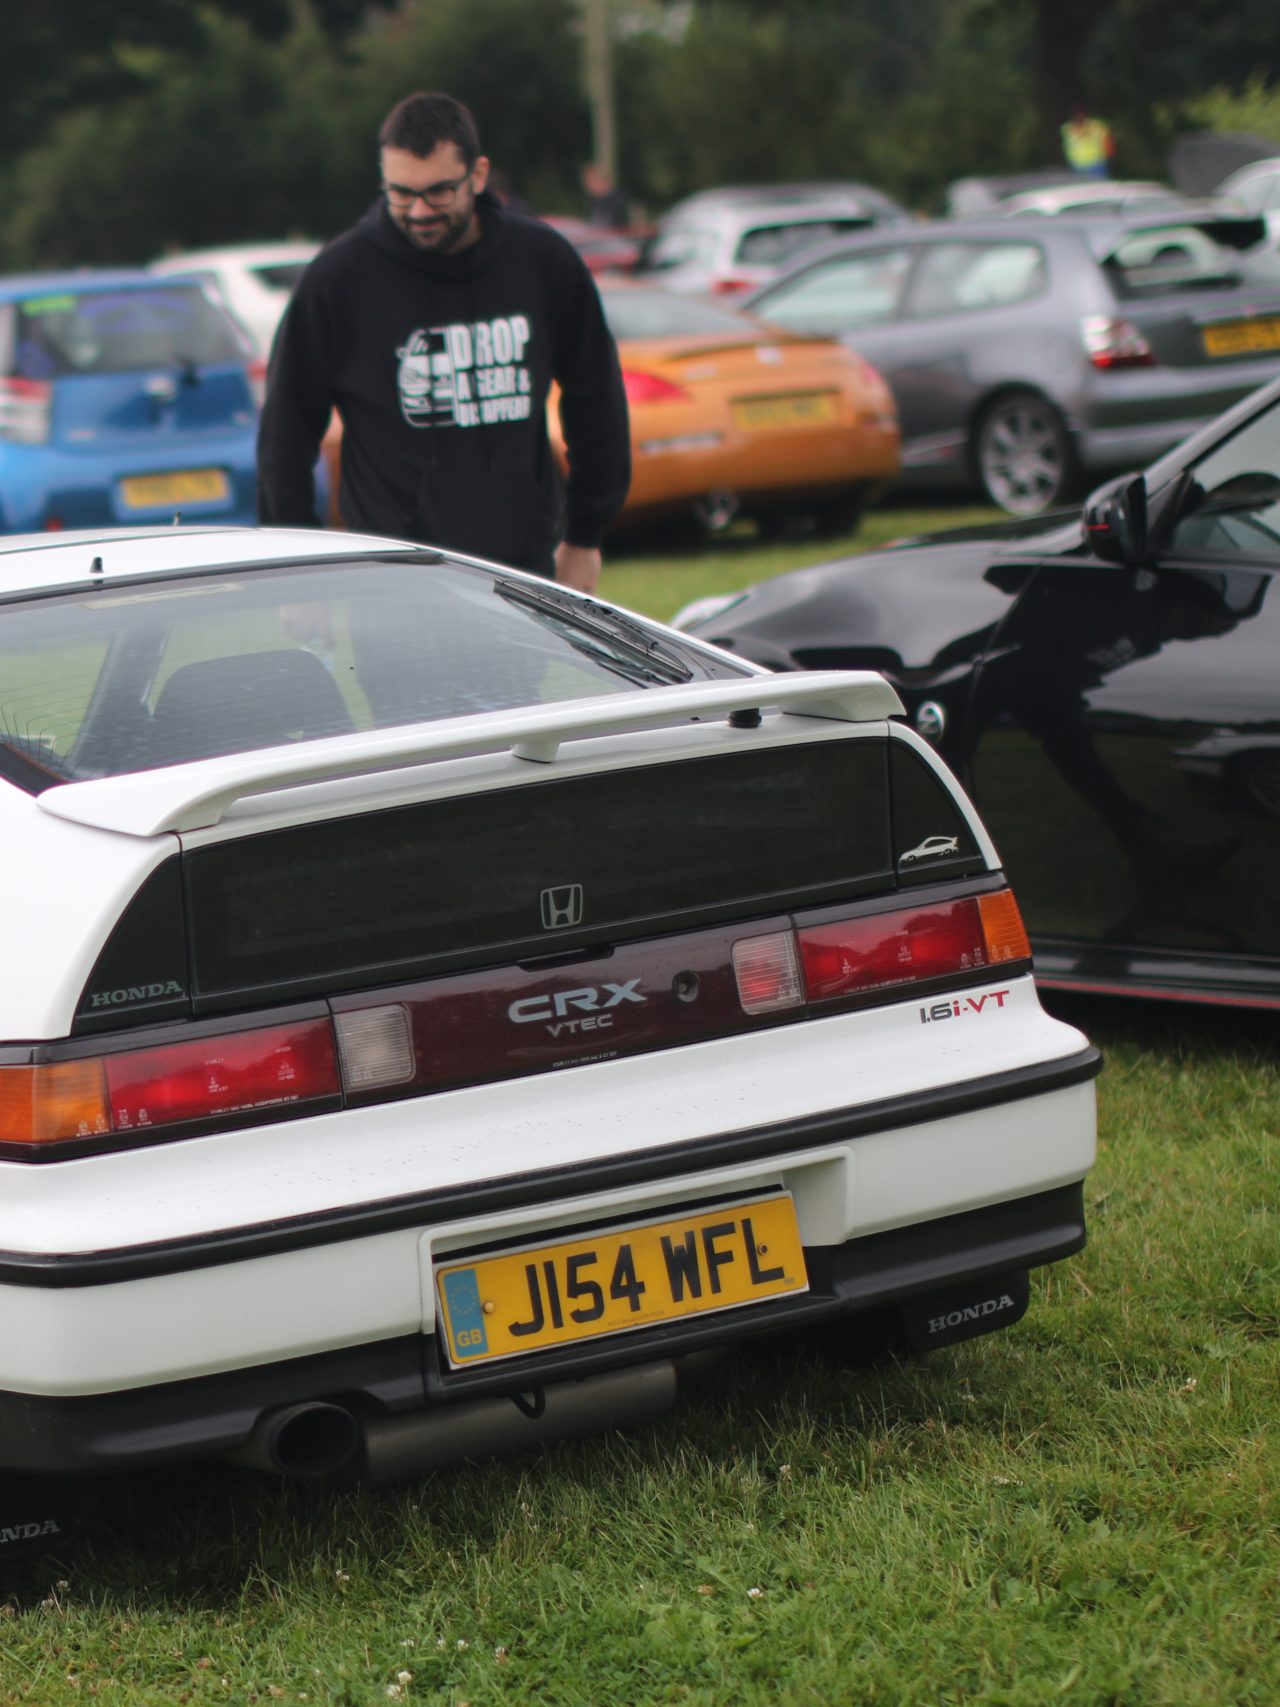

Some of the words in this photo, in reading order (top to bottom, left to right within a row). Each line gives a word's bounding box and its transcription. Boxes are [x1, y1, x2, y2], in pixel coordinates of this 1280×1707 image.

[451, 315, 530, 370] DROP
[456, 372, 470, 400] A
[518, 368, 530, 393] &
[91, 980, 182, 1007] HONDA
[508, 978, 648, 1023] CRX
[545, 1013, 613, 1038] VTEC
[508, 1243, 646, 1337] J154
[660, 1218, 785, 1303] WFL
[927, 1294, 1015, 1334] HONDA
[456, 1328, 483, 1347] GB
